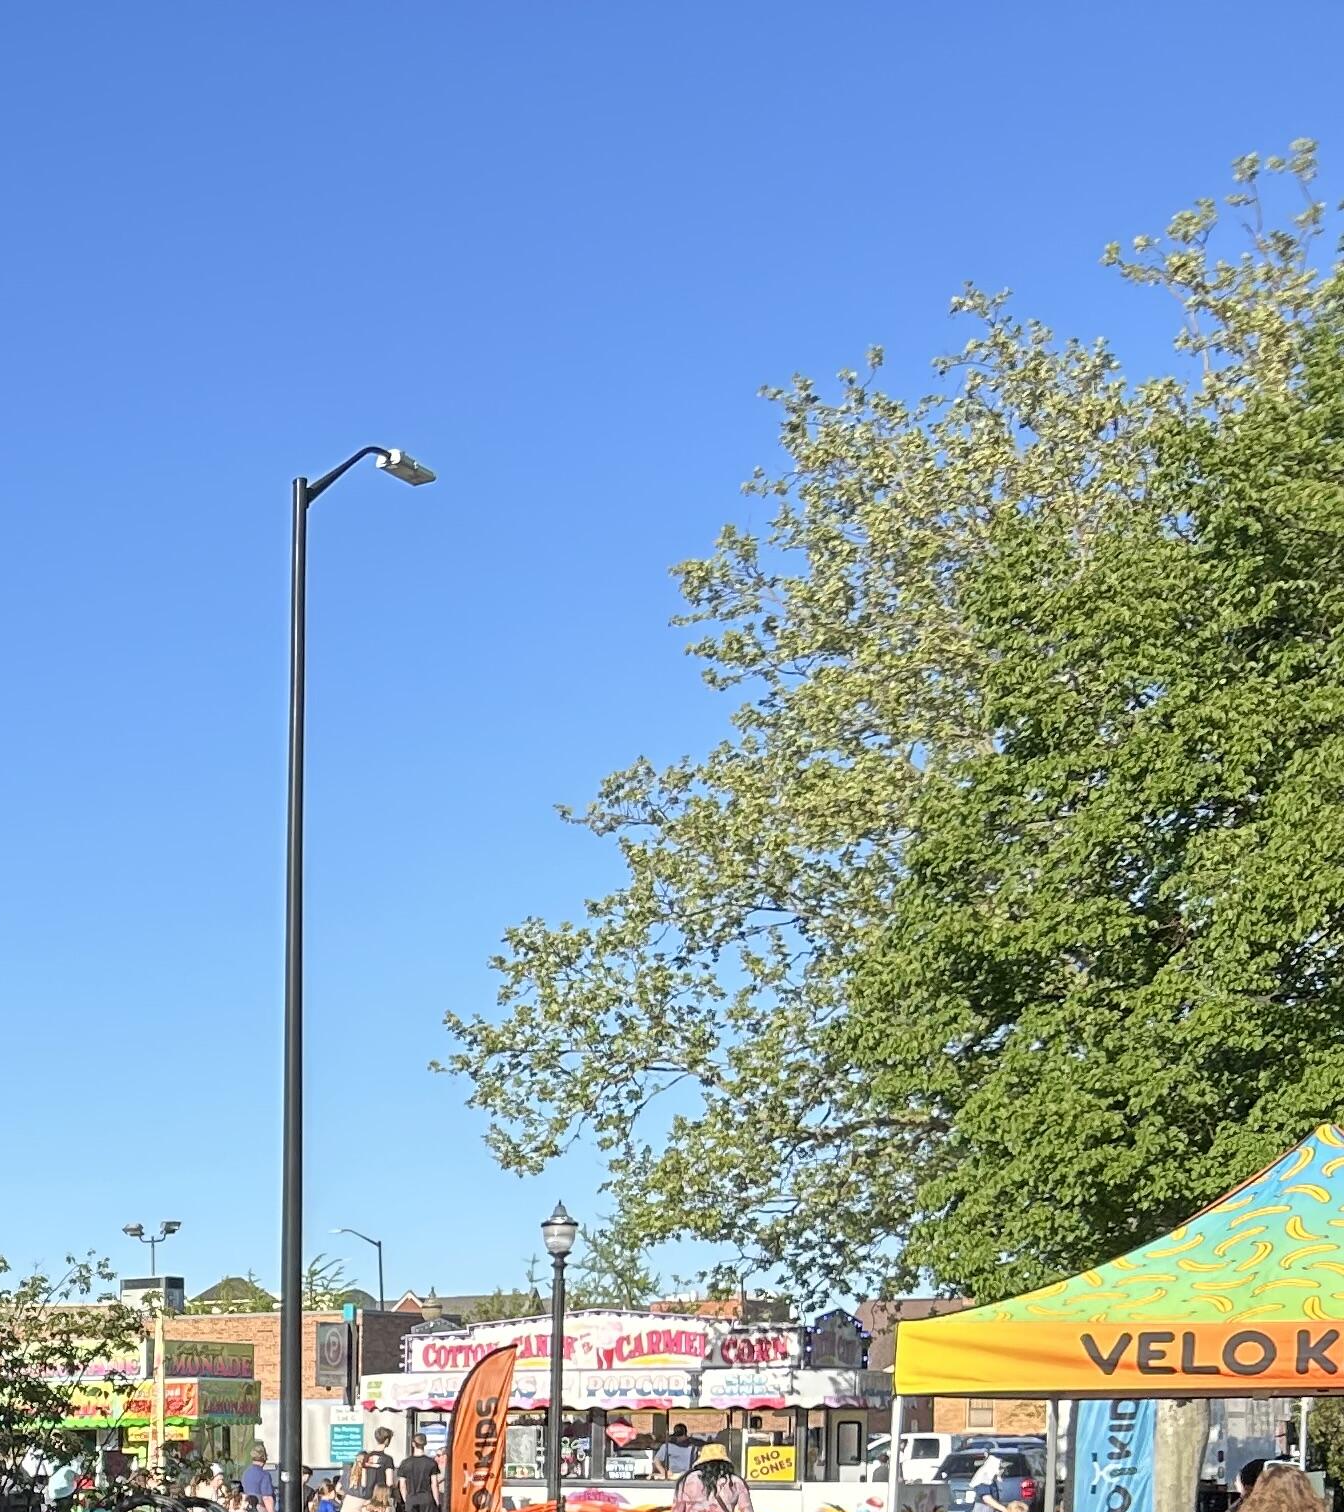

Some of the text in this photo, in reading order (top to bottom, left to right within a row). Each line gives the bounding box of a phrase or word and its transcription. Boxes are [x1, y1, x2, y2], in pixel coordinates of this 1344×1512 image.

[615, 1330, 708, 1359] CARMEL
[721, 1336, 790, 1364] CORN
[1080, 1330, 1277, 1375] VELO
[1107, 1400, 1138, 1460] KID
[750, 1457, 793, 1479] CONES
[753, 1450, 780, 1465] SNO
